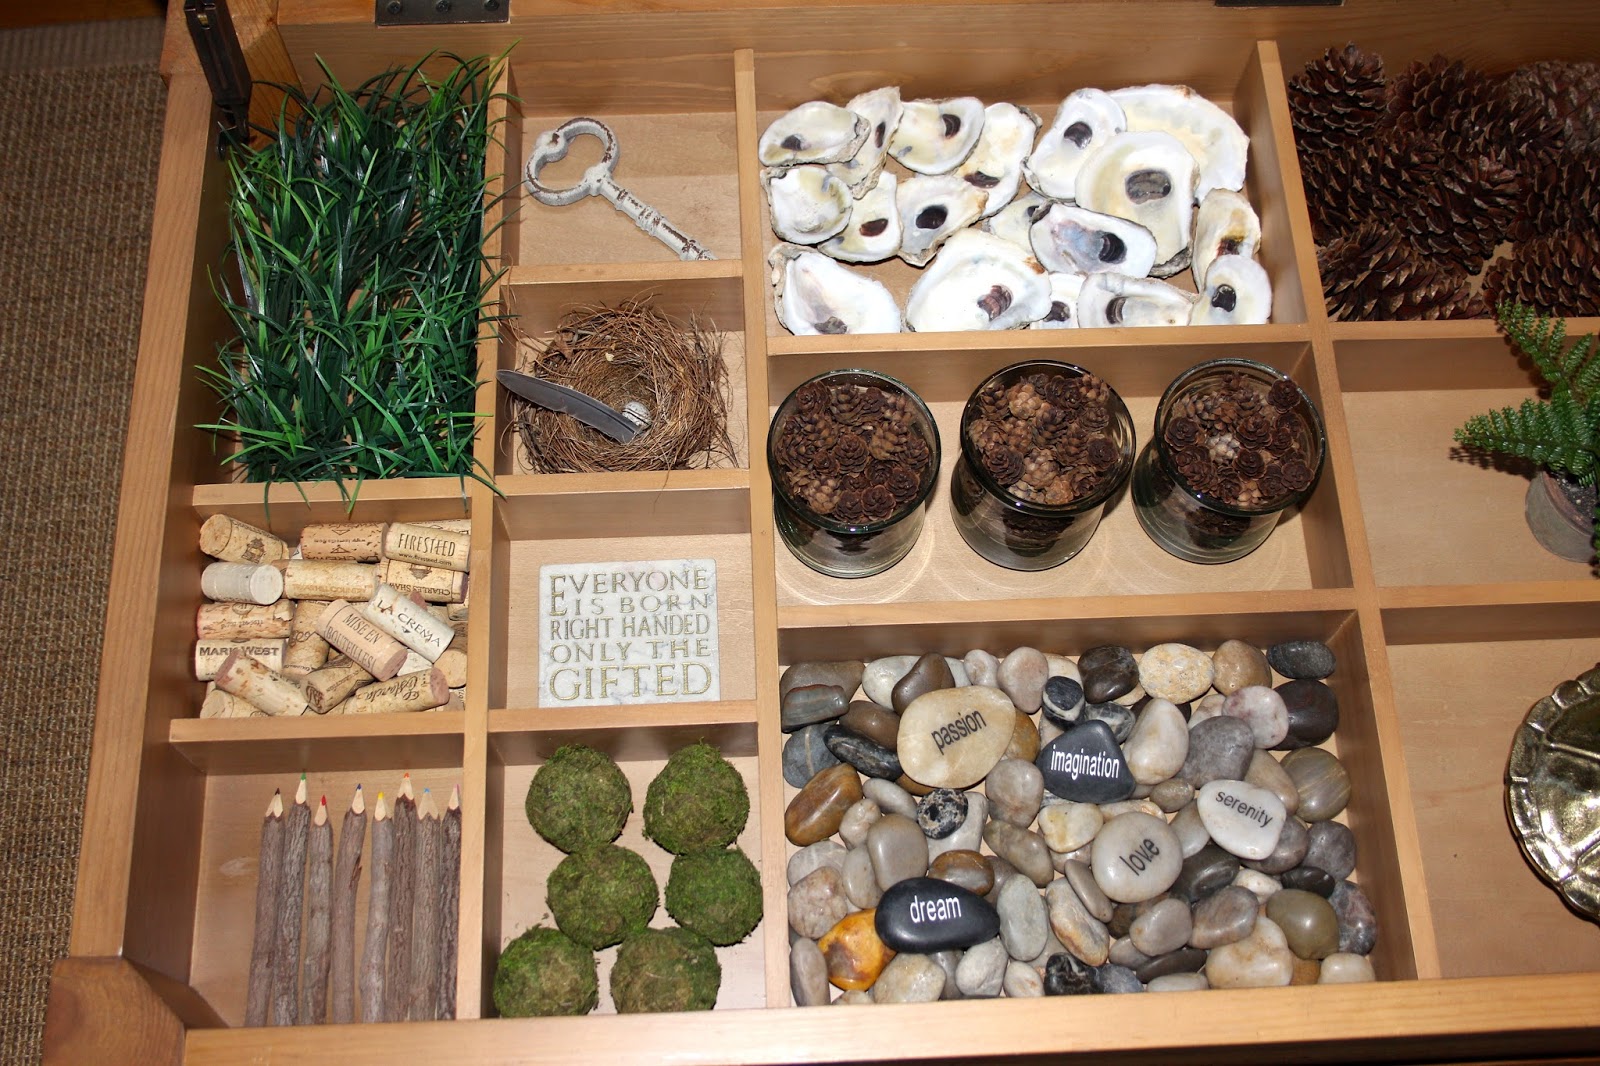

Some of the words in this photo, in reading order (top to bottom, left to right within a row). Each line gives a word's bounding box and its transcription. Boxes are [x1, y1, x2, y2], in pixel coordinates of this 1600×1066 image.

[398, 533, 456, 557] FIRESTEED
[412, 585, 451, 596] CHARLES
[549, 568, 708, 616] EVERYONE
[575, 597, 605, 615] IS
[620, 593, 709, 614] BORN
[343, 613, 370, 635] MISE
[364, 629, 383, 644] EN
[377, 600, 392, 615] LA
[398, 613, 440, 647] CREMA
[551, 617, 613, 640] RIGHT
[621, 613, 710, 638] HANDED
[241, 646, 279, 656] WEST
[551, 641, 632, 663] ONLY
[645, 638, 711, 659] THE
[550, 663, 712, 701] GIFTED
[931, 710, 987, 755] passion
[1051, 744, 1120, 780] imagination
[1215, 791, 1274, 828] serenity
[1119, 838, 1160, 876] love
[910, 895, 962, 924] dream
